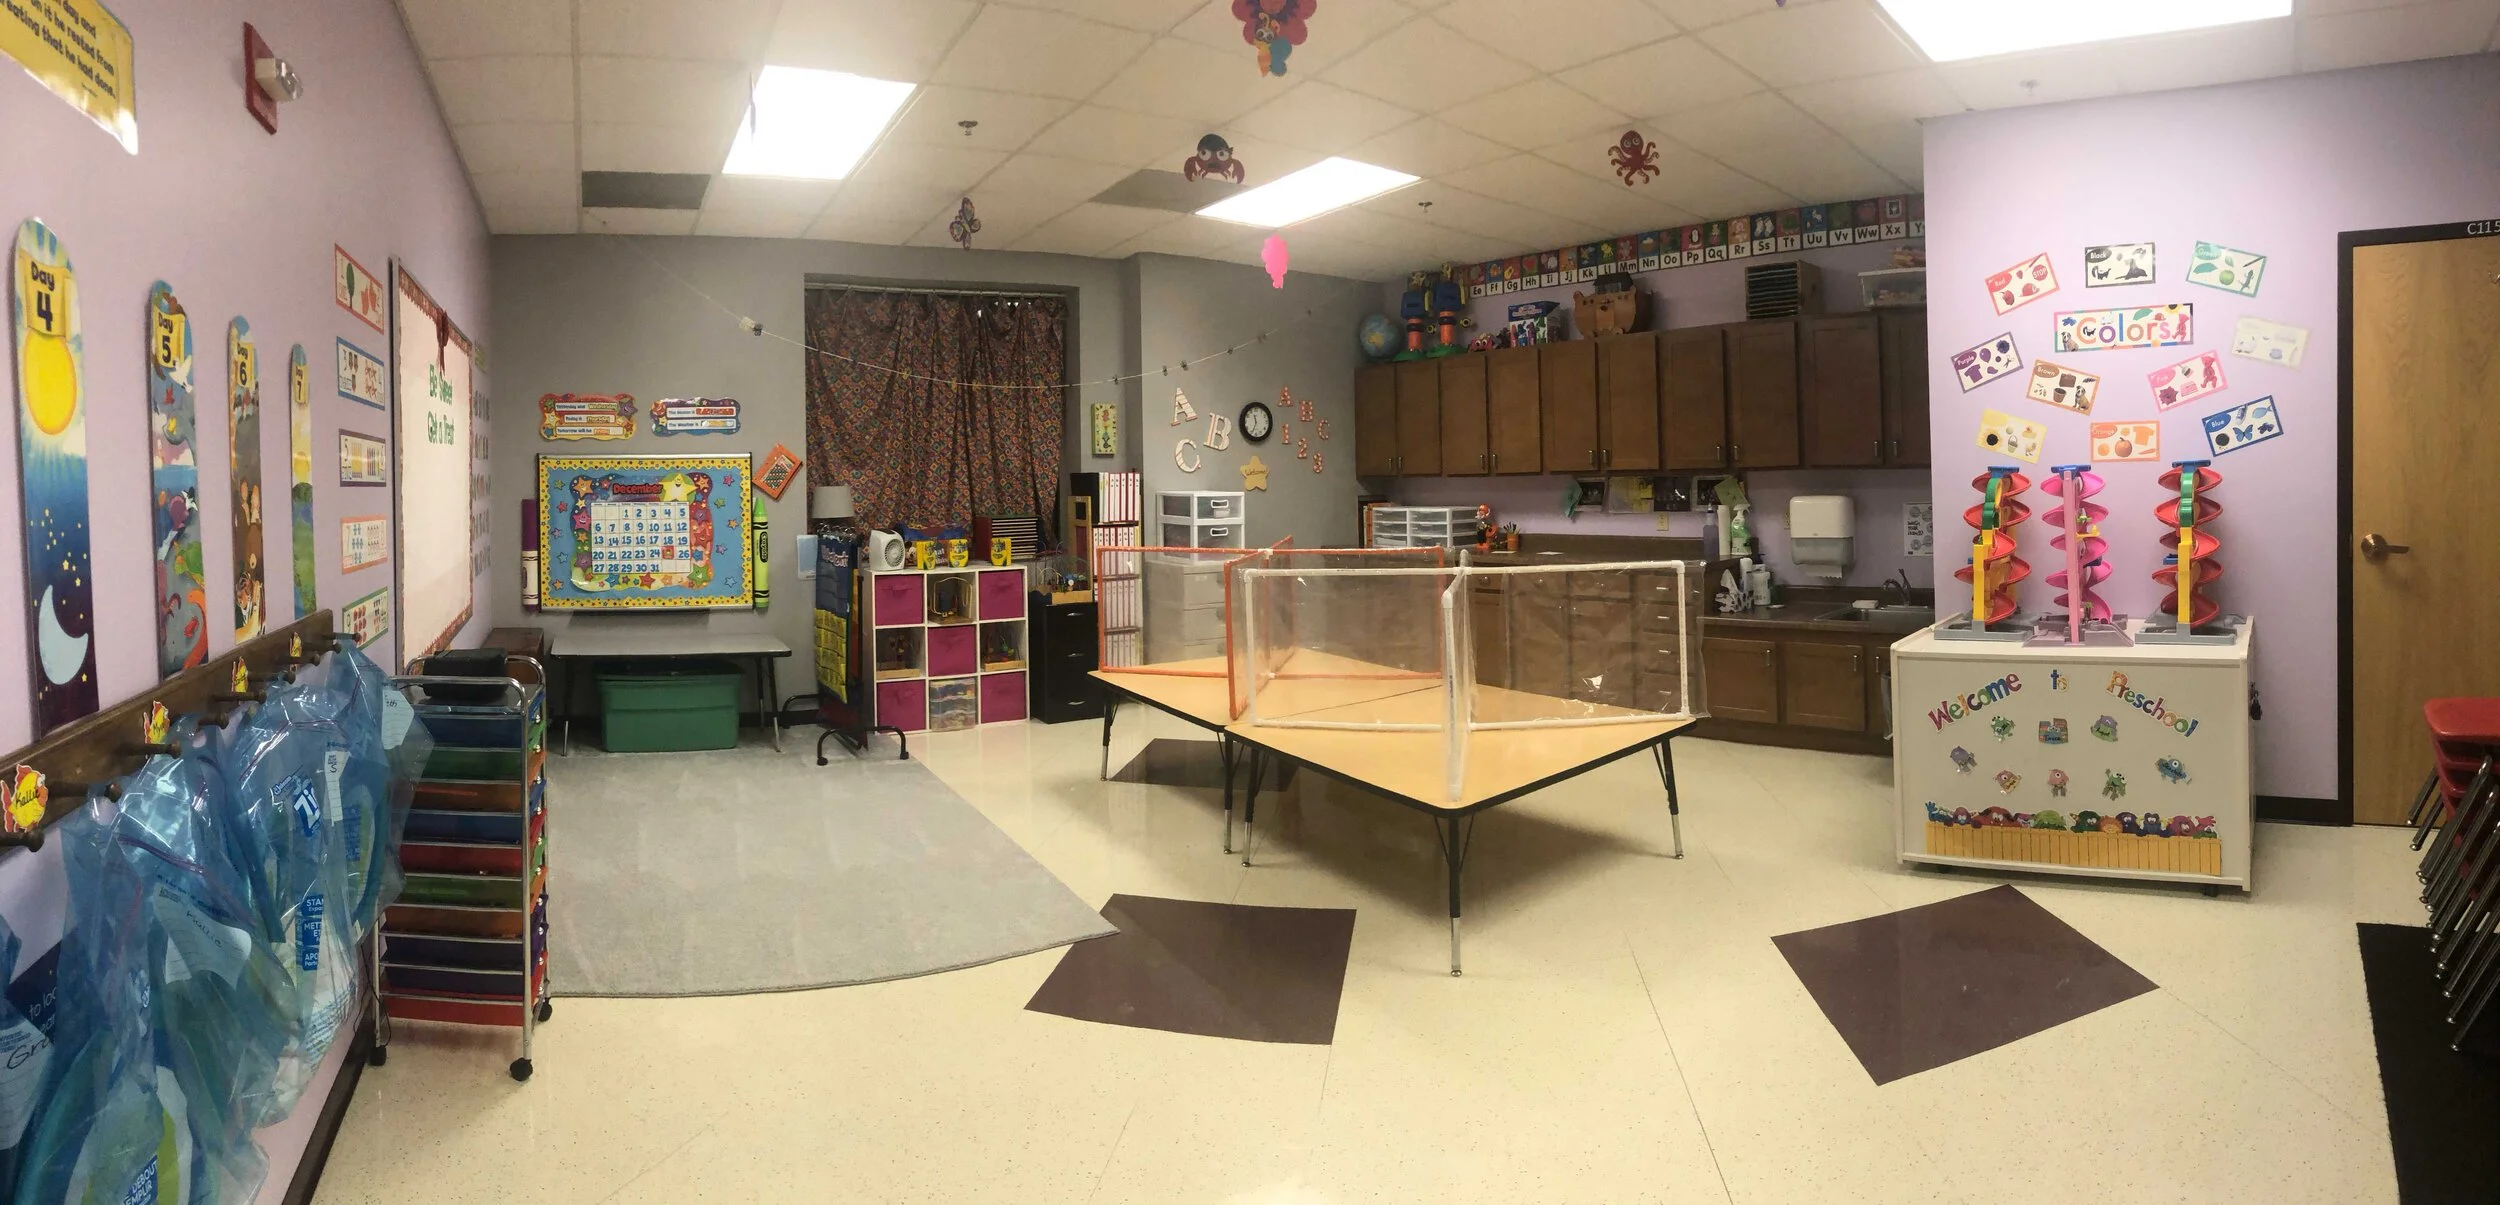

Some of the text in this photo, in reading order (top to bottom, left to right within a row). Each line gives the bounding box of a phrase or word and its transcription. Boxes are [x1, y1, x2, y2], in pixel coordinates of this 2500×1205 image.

[80, 17, 97, 39] and
[43, 3, 53, 22] it
[67, 26, 95, 60] rested
[96, 48, 115, 77] from
[42, 25, 64, 55] that
[65, 44, 76, 65] he
[77, 55, 94, 81] had
[94, 72, 116, 100] done.
[1886, 225, 1901, 236] Xx
[2467, 220, 2500, 235] C115
[1807, 233, 1823, 245] Uu
[1835, 231, 1849, 242] Vv
[1858, 228, 1877, 239] Ww
[1758, 241, 1770, 251] Ss
[1783, 237, 1795, 248] Tt
[1708, 248, 1724, 260] Qq
[1735, 244, 1745, 255] Rr
[1664, 255, 1677, 265] Oo
[1687, 253, 1699, 263] Pp
[2090, 251, 2107, 260] Black
[1619, 261, 1637, 271] Mm
[1642, 257, 1656, 268] Nn
[31, 260, 55, 292] Day
[1546, 273, 1553, 284] Ii
[1565, 272, 1573, 283] Jj
[1582, 269, 1594, 278] Kk
[2032, 267, 2047, 279] STOP
[1507, 280, 1518, 291] Gg
[1525, 276, 1537, 287] Hh
[1490, 283, 1498, 292] Ff
[37, 290, 53, 332] 4
[158, 312, 173, 334] Day
[2076, 312, 2171, 345] Colors
[162, 335, 171, 363] 5
[236, 342, 248, 360] Day
[1957, 355, 1975, 366] Purple
[239, 361, 248, 386] 6
[2037, 366, 2056, 376] Brown
[296, 380, 302, 400] 7
[1277, 385, 1331, 440] A B C
[427, 411, 437, 444] Get
[2211, 418, 2225, 428] Blue
[1171, 387, 1232, 473] A B C
[1281, 423, 1323, 474] 1 2 3
[612, 482, 664, 495] December
[624, 508, 686, 518] 1 2 3 4 5
[595, 522, 687, 532] 6 7 8 9 10 11 12
[594, 536, 688, 546] 13 14 15 16 17 18 19
[593, 549, 689, 560] 20 21 22 23 24 26
[594, 564, 659, 572] 27 28 29 30 31
[1928, 668, 2200, 738] Welcome to Preschool
[293, 787, 321, 829] Zi
[28, 1004, 42, 1021] to
[132, 1160, 157, 1194] DEBOUT
